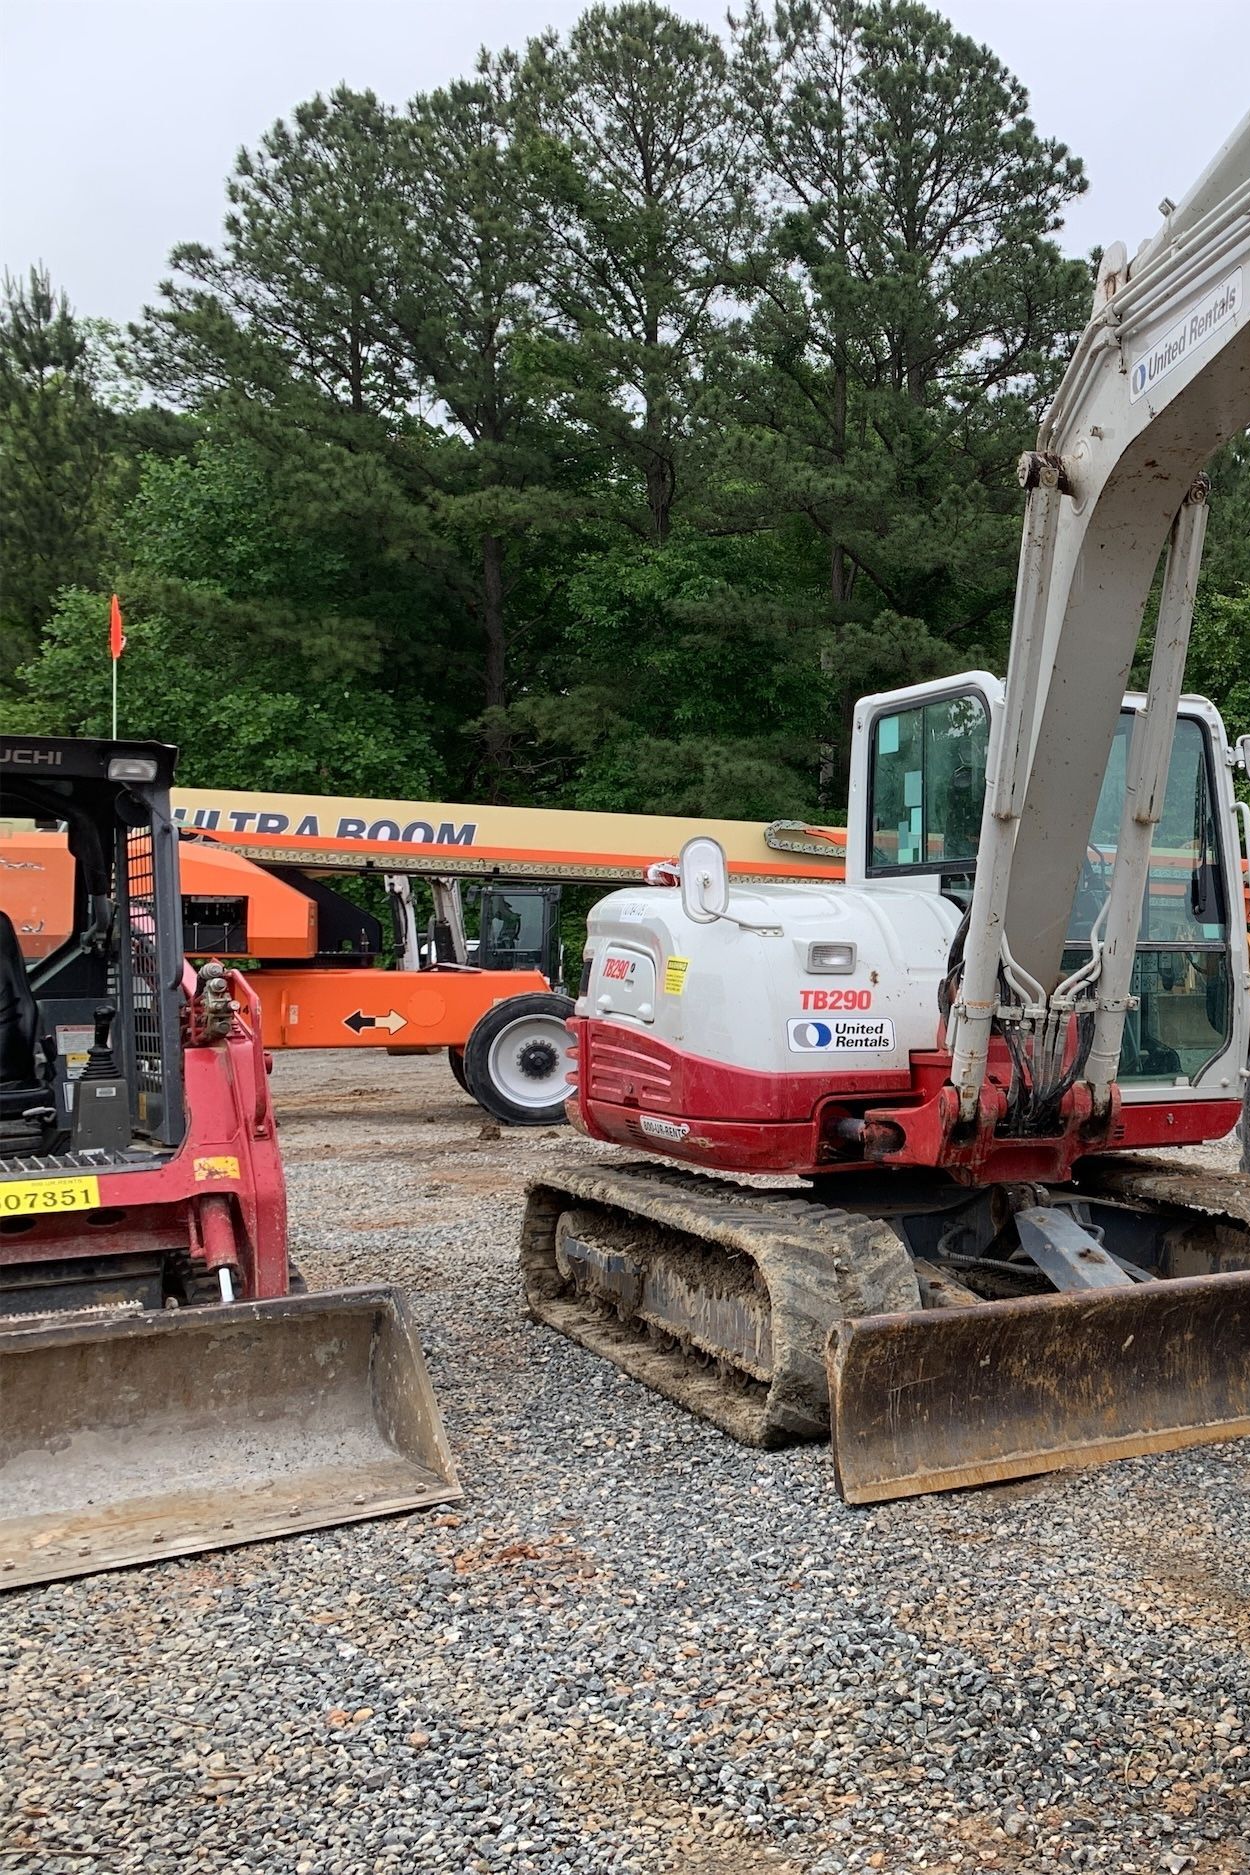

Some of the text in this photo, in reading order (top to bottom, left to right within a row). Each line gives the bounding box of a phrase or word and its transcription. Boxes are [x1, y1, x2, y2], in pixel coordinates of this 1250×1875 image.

[1148, 285, 1236, 381] United Rentals
[335, 817, 478, 847] BOOM
[800, 990, 872, 1010] TB290
[835, 1023, 884, 1034] United
[836, 1036, 890, 1048] Rentals
[0, 1189, 91, 1210] 07351
